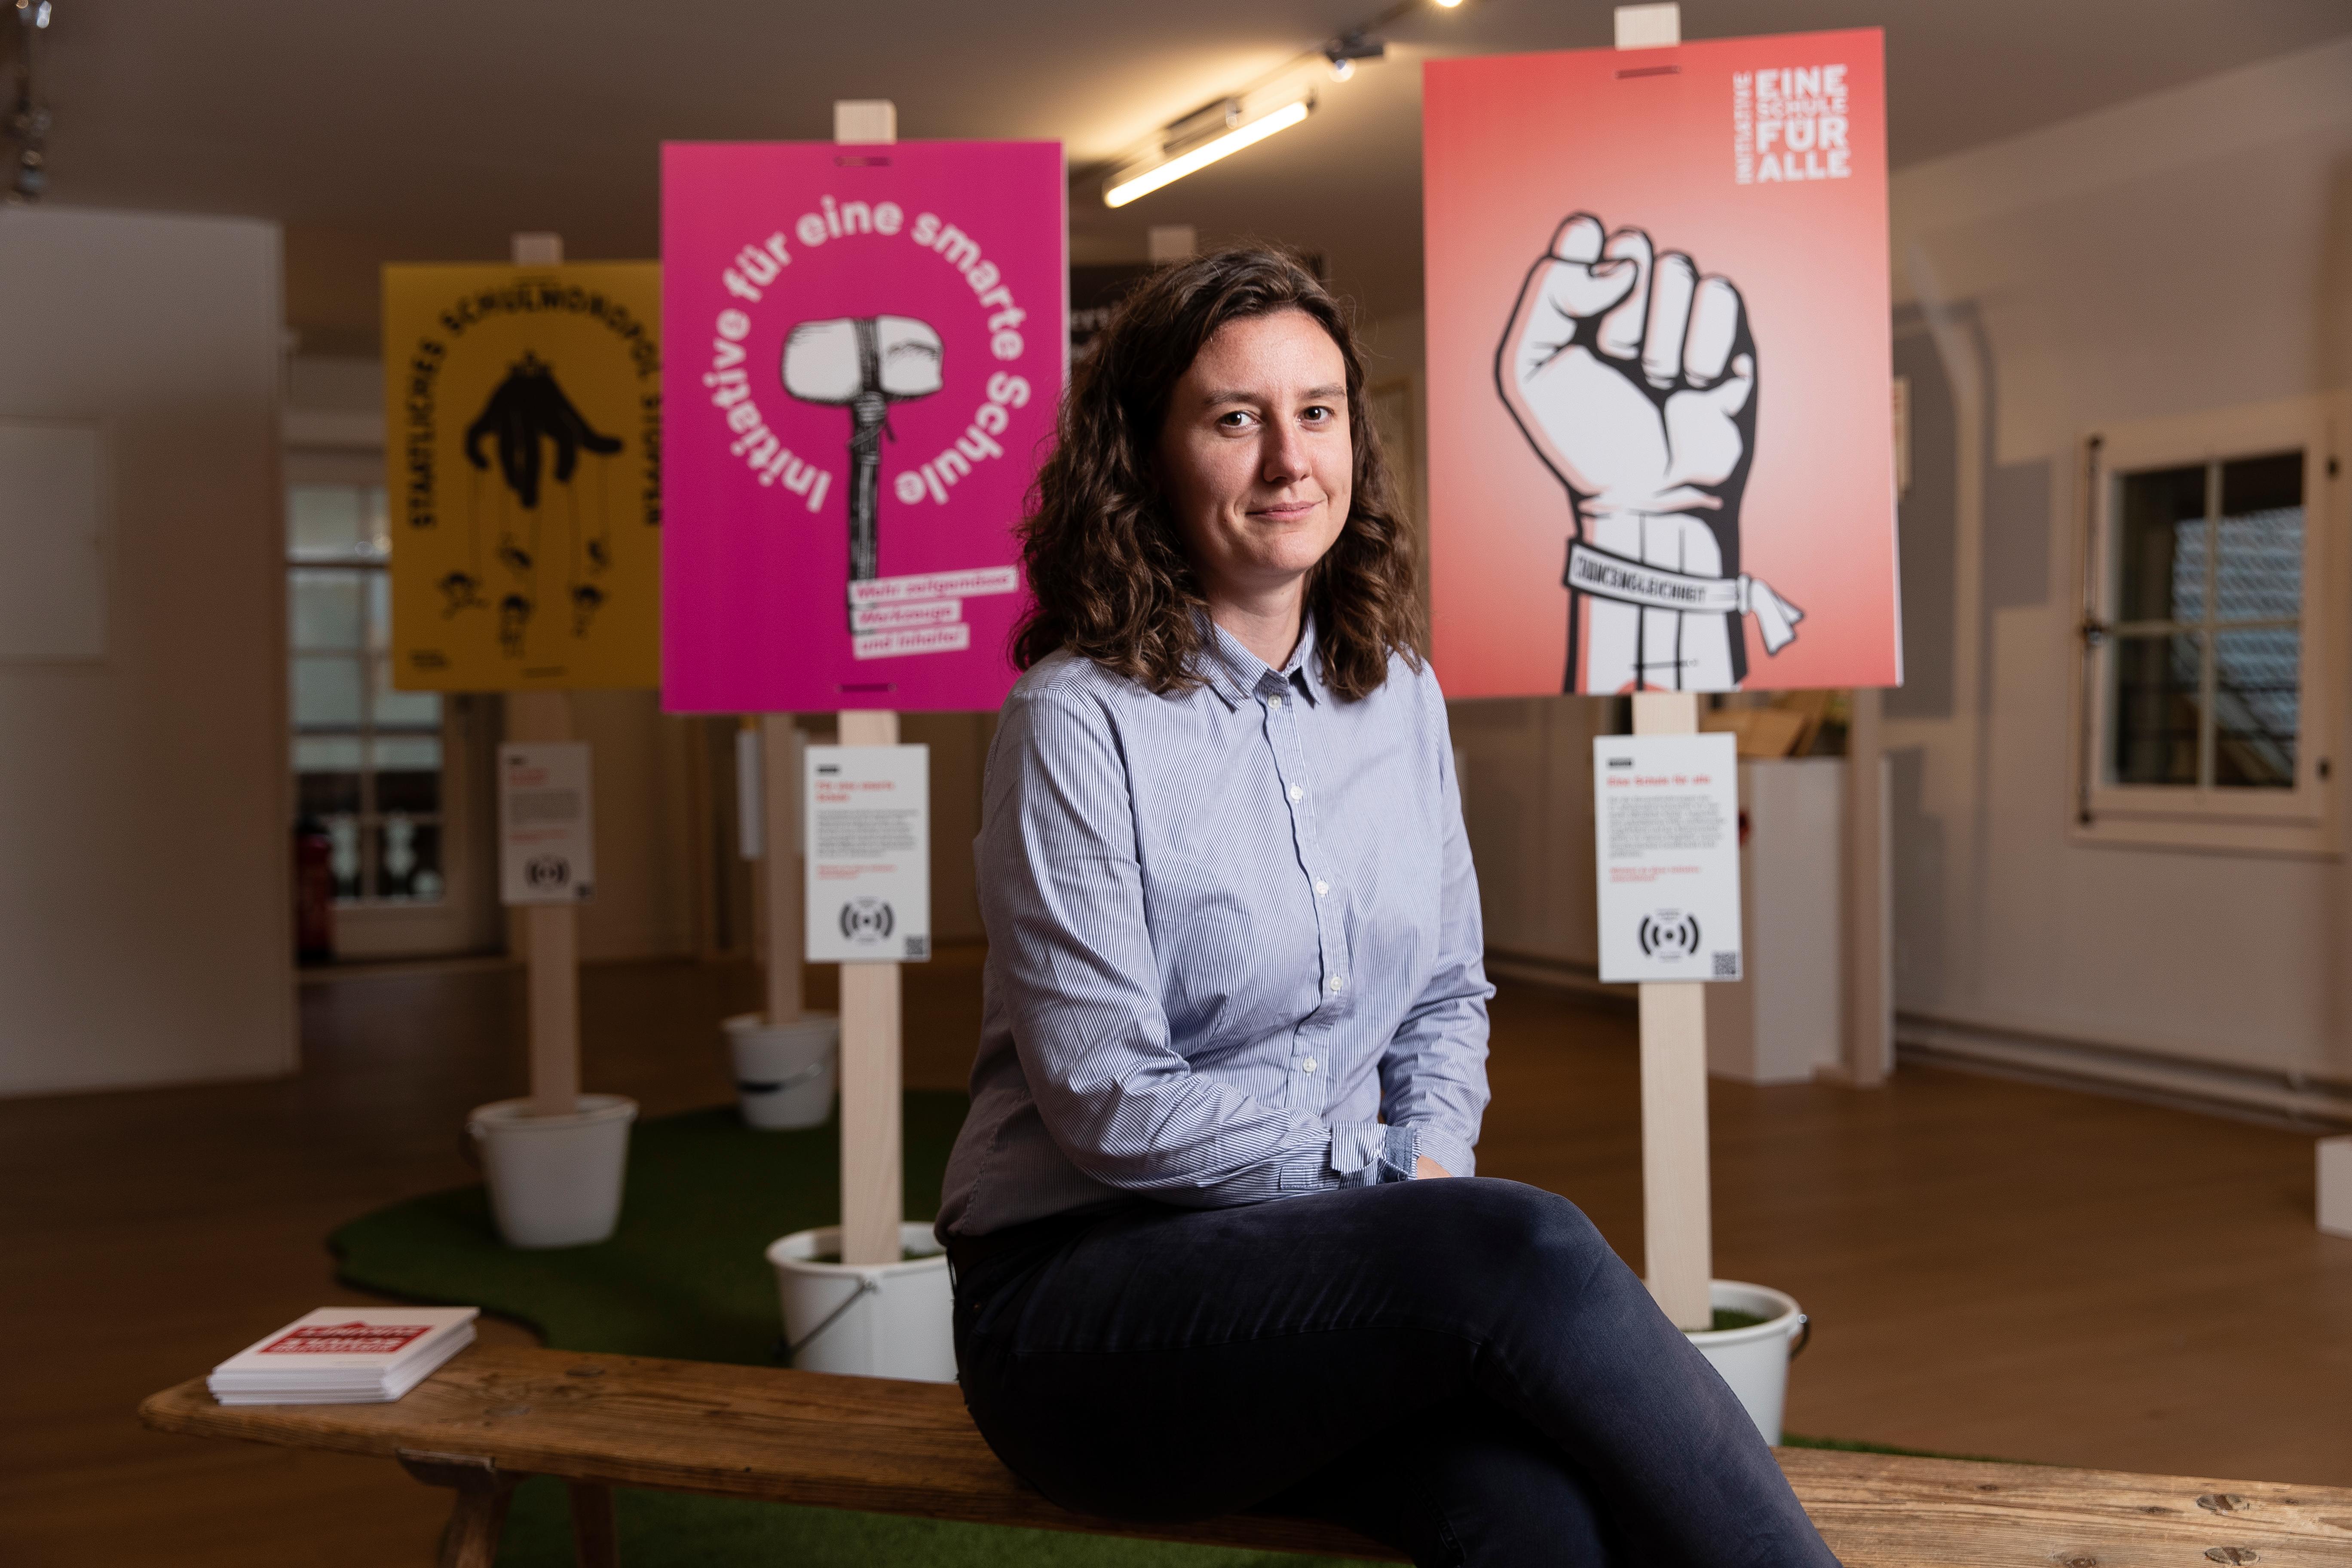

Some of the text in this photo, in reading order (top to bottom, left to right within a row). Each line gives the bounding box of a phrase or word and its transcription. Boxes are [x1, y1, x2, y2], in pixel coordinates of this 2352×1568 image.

[1756, 64, 1849, 100] EINE
[1757, 97, 1849, 120] SCHULE
[1756, 116, 1850, 153] FÜR
[1757, 149, 1852, 183] ALLE
[703, 195, 1030, 512] Initiative für eine smarte Schule
